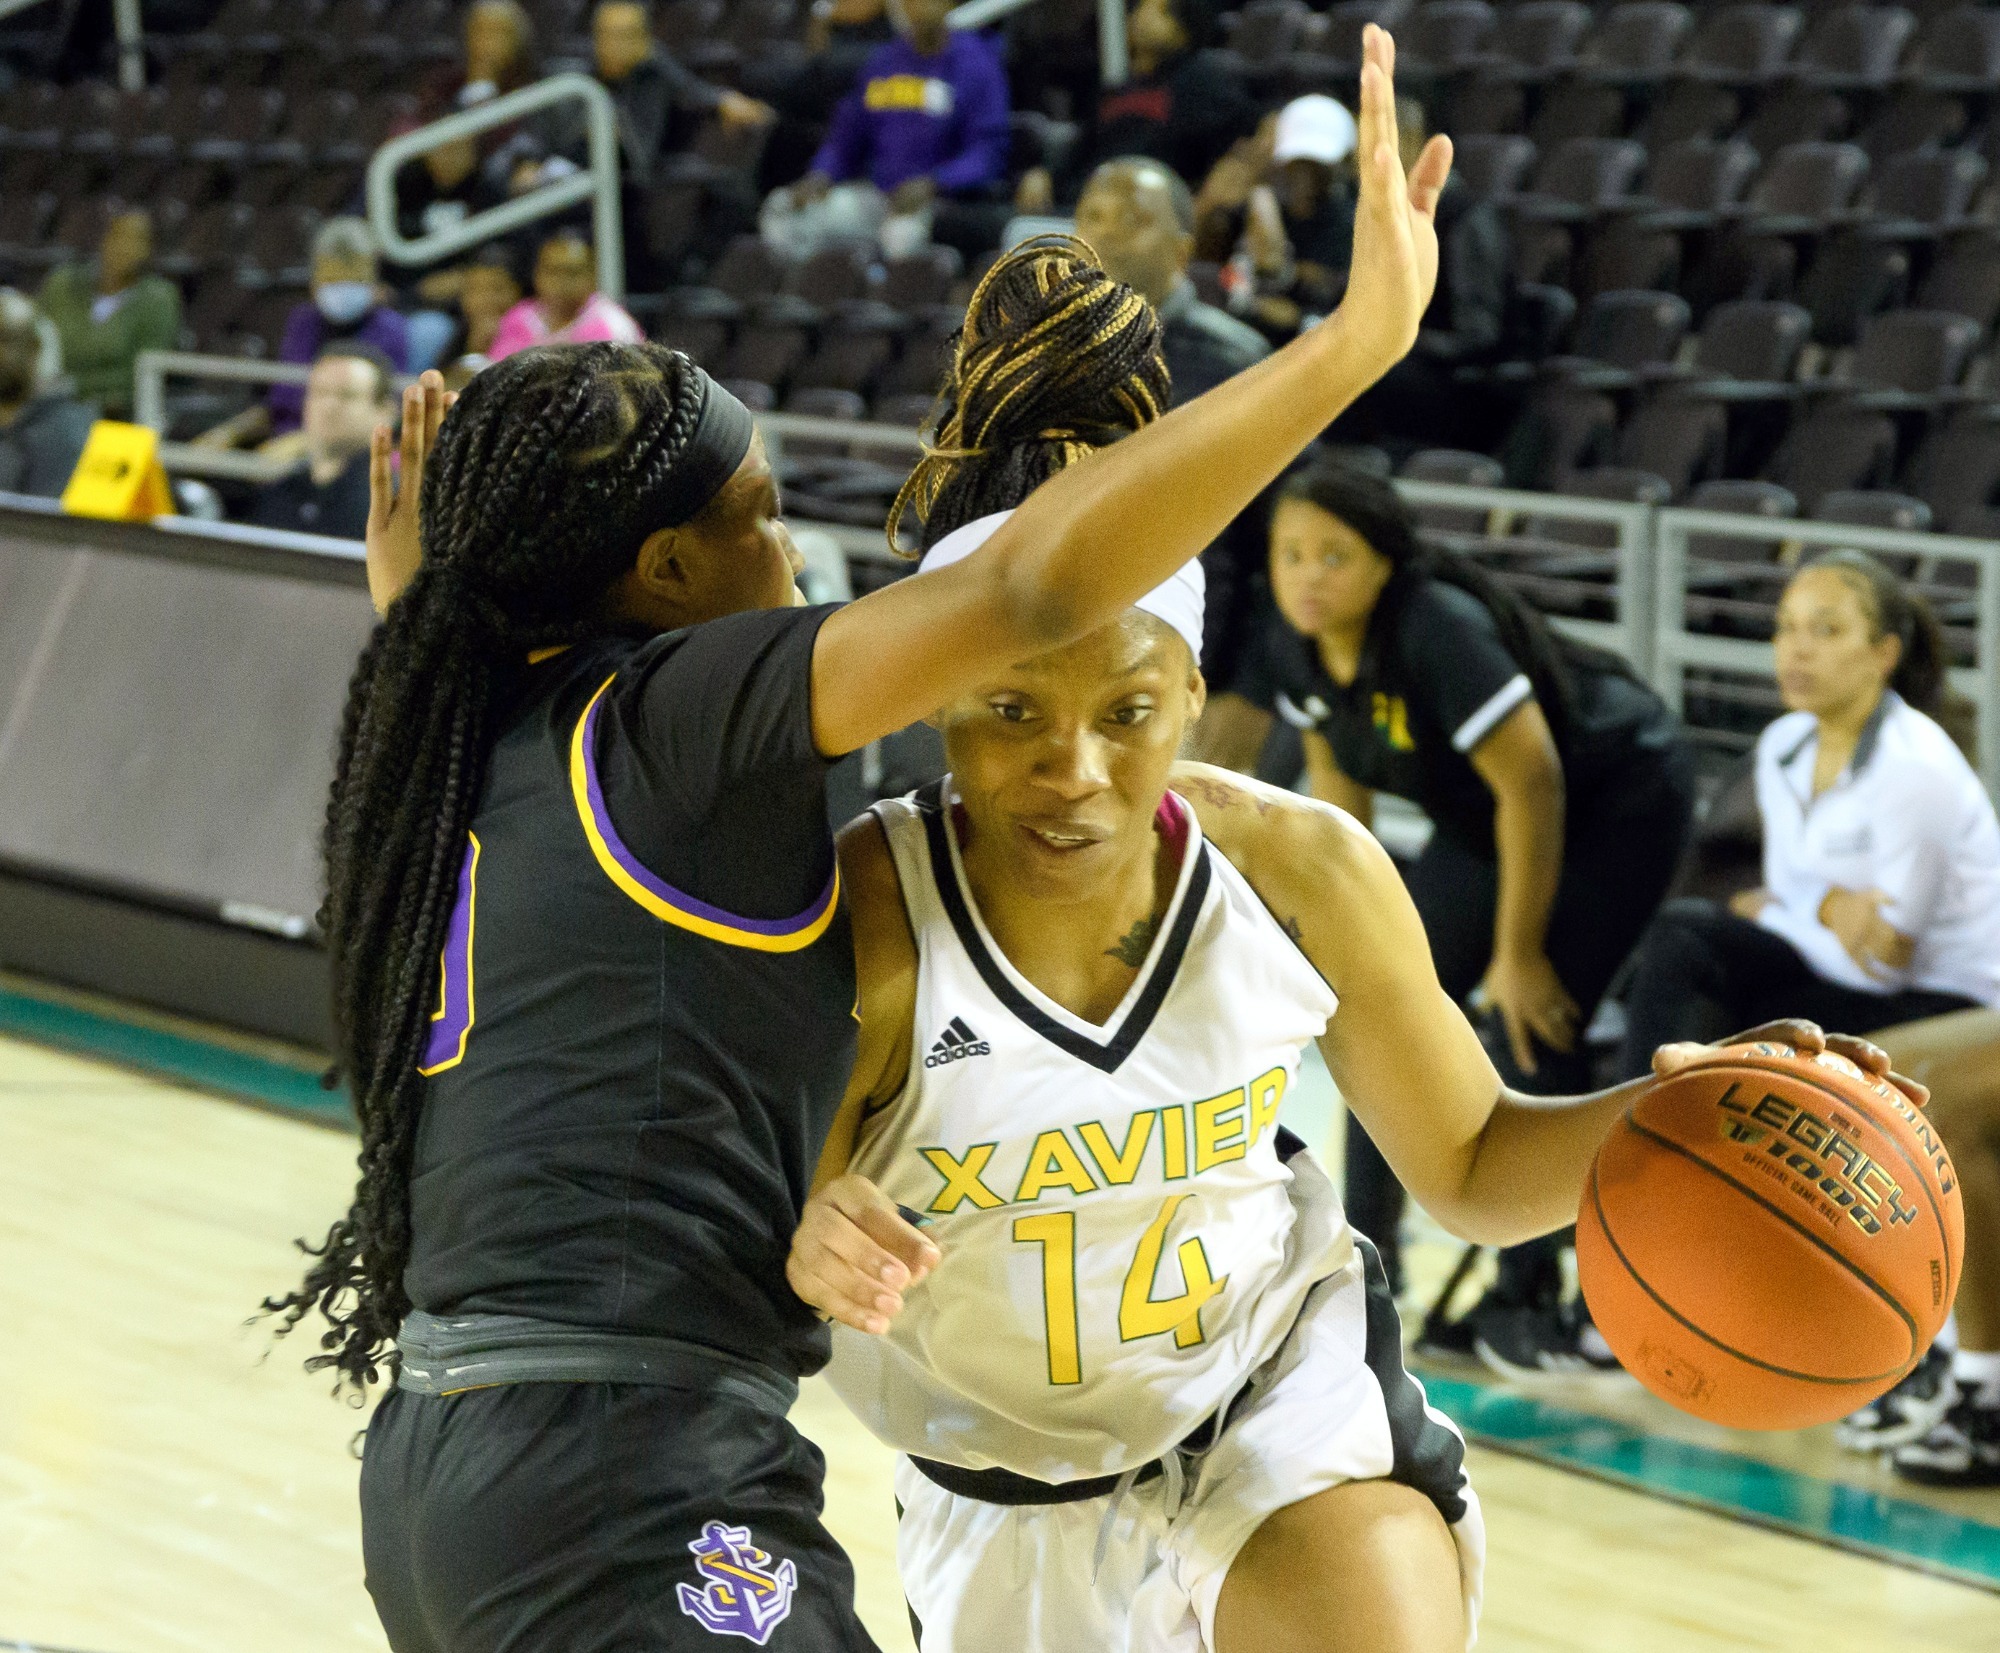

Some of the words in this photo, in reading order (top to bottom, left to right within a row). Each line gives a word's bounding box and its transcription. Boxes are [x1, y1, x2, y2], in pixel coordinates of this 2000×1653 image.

[925, 1041, 991, 1069] adidas
[917, 1066, 1288, 1214] XAVIER
[1717, 1081, 1918, 1229] LEGACY
[1741, 1151, 1790, 1185] OFFICIAL
[1789, 1179, 1818, 1205] GAME
[1818, 1201, 1842, 1229] BALL
[1012, 1193, 1231, 1386] 14
